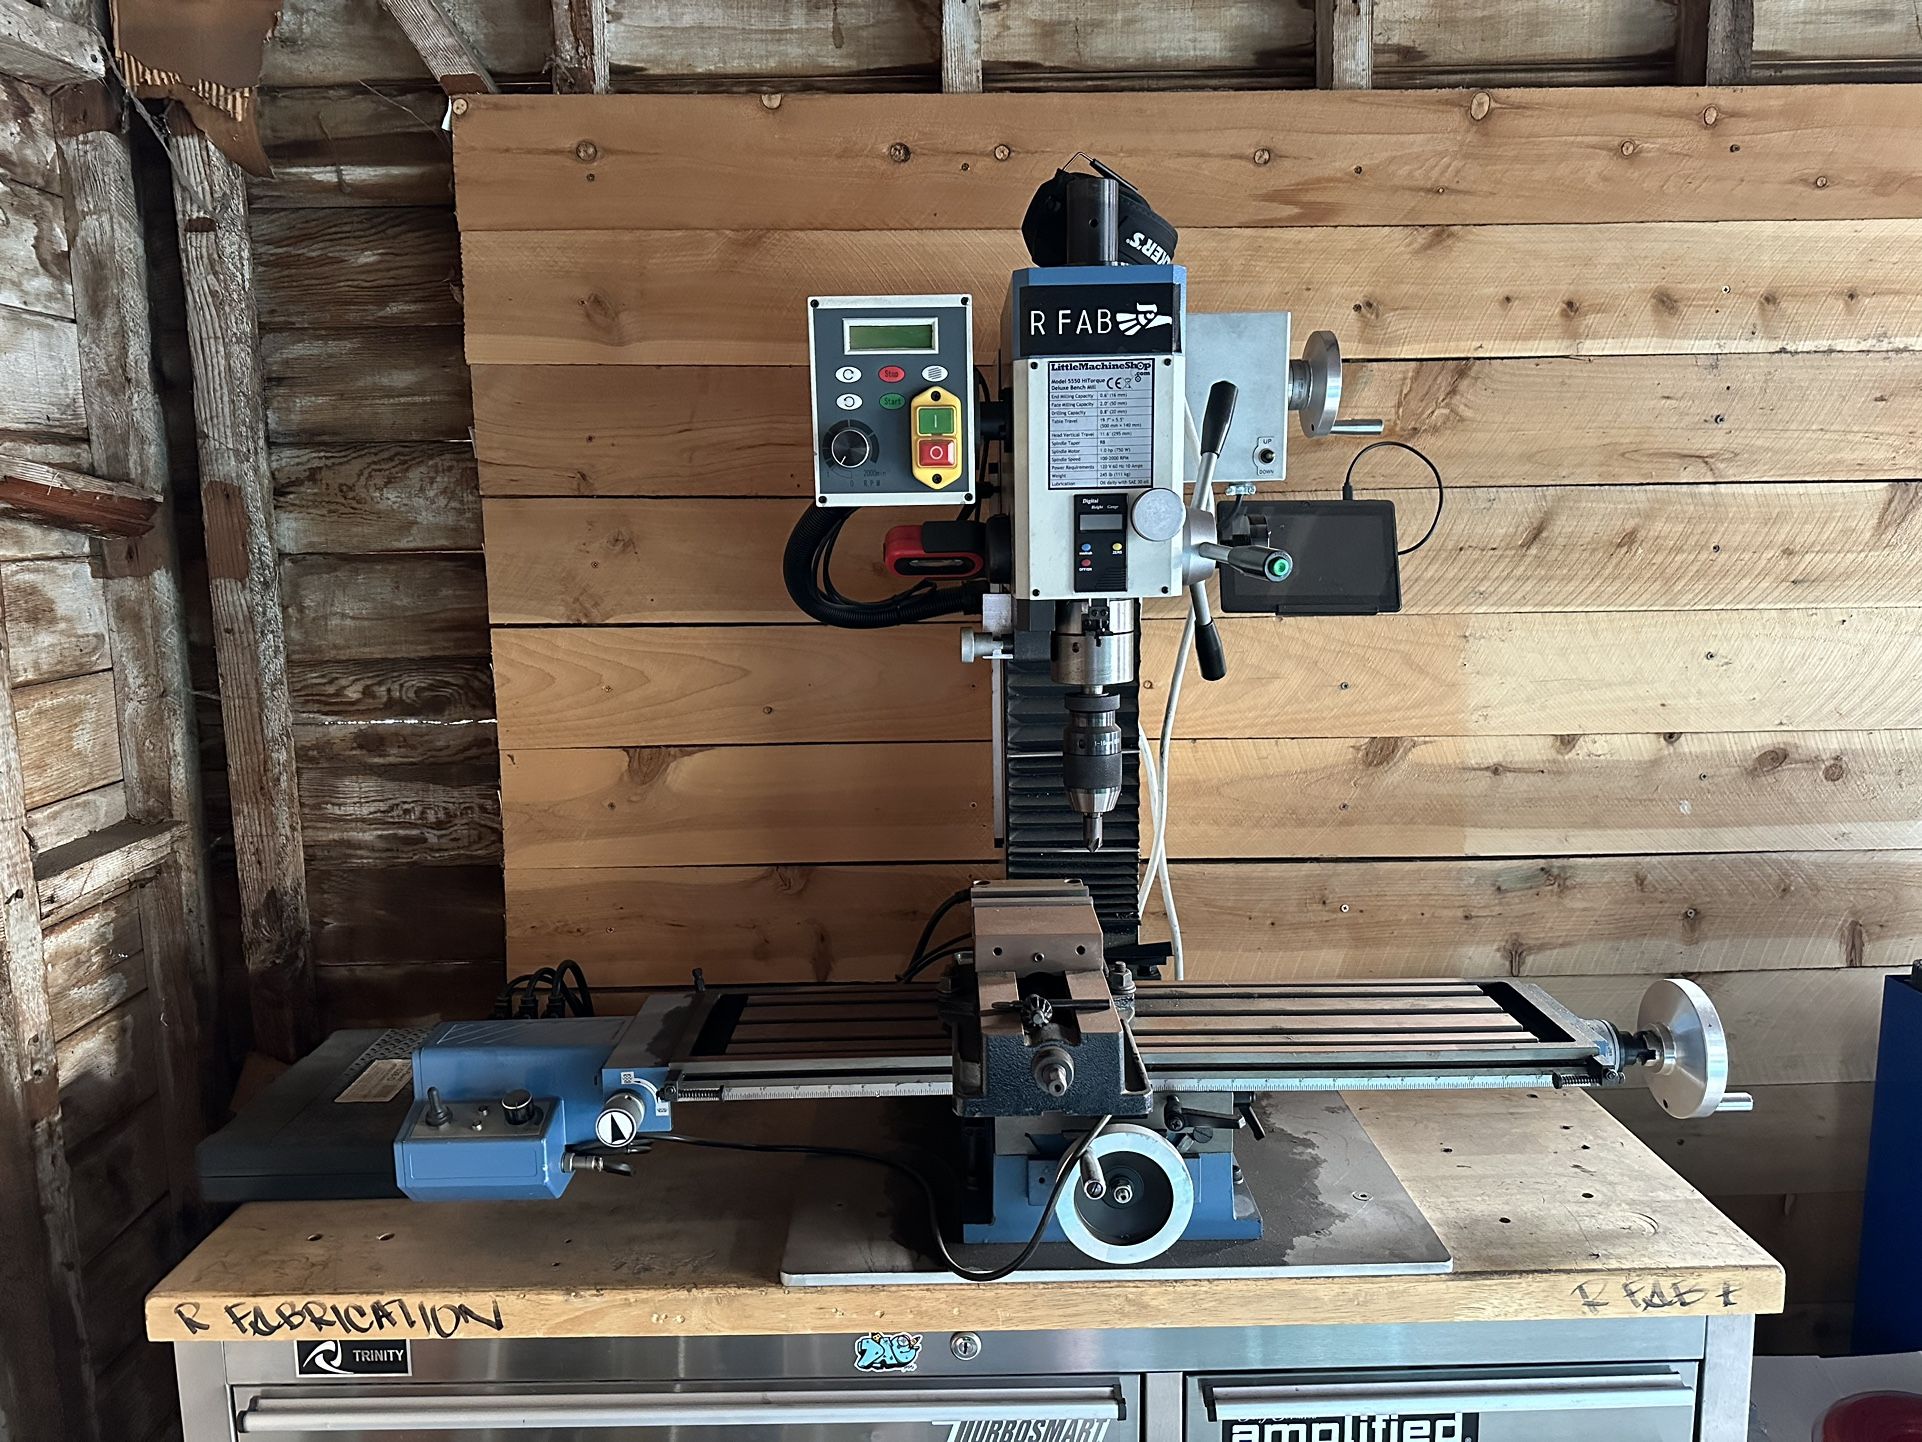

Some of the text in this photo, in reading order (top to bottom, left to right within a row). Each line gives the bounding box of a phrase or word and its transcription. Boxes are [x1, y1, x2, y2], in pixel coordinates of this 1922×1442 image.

[1030, 309, 1112, 336] R FAB
[884, 369, 899, 378] Stop
[1051, 362, 1151, 371] LittleMachineShop
[884, 396, 902, 407] Start
[1570, 1279, 1609, 1314] R
[174, 1297, 505, 1338] R FABRICATION
[352, 1348, 404, 1363] TRINITY
[932, 1419, 1110, 1442] TURBOSMART
